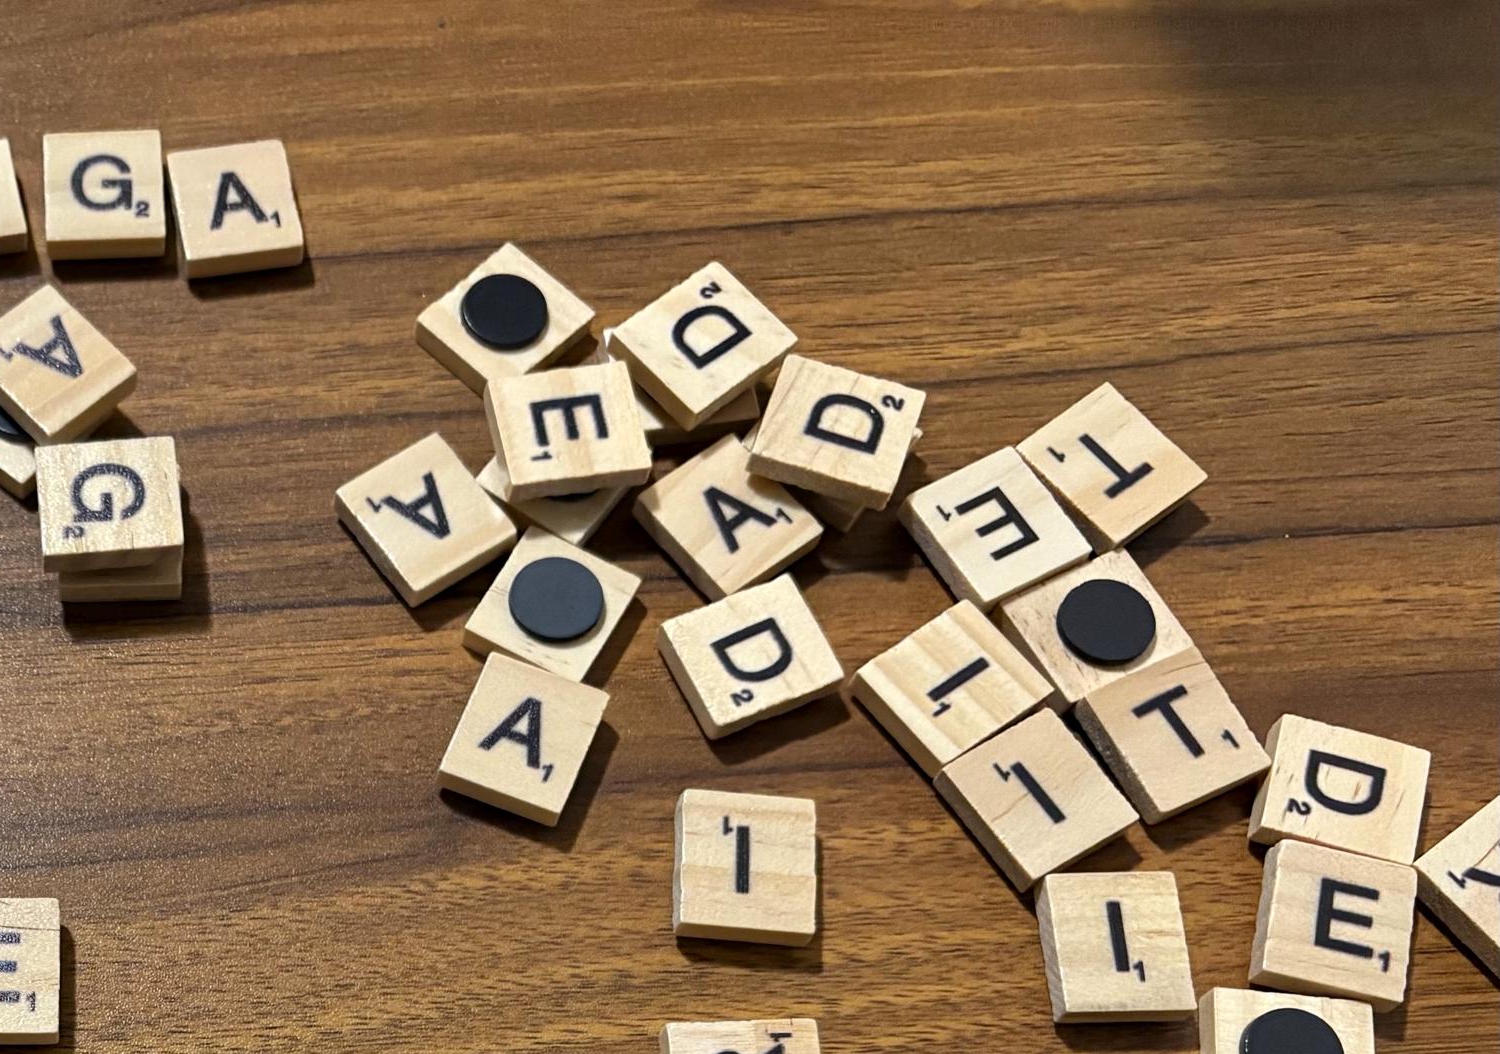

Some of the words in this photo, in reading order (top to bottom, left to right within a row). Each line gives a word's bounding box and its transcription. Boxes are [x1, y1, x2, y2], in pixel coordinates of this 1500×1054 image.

[69, 152, 134, 212] G
[134, 200, 151, 218] 2
[209, 171, 269, 230] A
[699, 282, 721, 301] 2
[12, 314, 82, 379] A
[671, 304, 752, 371] D
[529, 393, 609, 446] E
[803, 393, 885, 456] D
[881, 394, 904, 411] 2
[531, 450, 553, 462] 1
[1046, 445, 1066, 463] 1
[1080, 433, 1154, 499] T
[70, 462, 146, 525] G
[366, 493, 382, 514] 1
[379, 473, 451, 540] A
[705, 486, 777, 554] A
[775, 507, 795, 525] 1
[936, 503, 952, 521] 1
[955, 486, 1040, 562] E
[711, 617, 794, 685] D
[927, 656, 988, 701] I
[731, 688, 755, 707] 2
[931, 700, 952, 718] 1
[1133, 684, 1206, 758] T
[1221, 728, 1239, 748] 1
[478, 697, 543, 770] A
[541, 762, 555, 782] 1
[994, 762, 1011, 782] 1
[1011, 761, 1066, 823] I
[1304, 749, 1387, 816] D
[722, 815, 734, 838] 1
[1285, 798, 1313, 816] 2
[735, 825, 750, 893] I
[1105, 900, 1130, 973] I
[1132, 959, 1147, 983] 1
[1313, 877, 1379, 959] E
[1378, 949, 1390, 971] 1
[767, 1031, 793, 1045] 1
